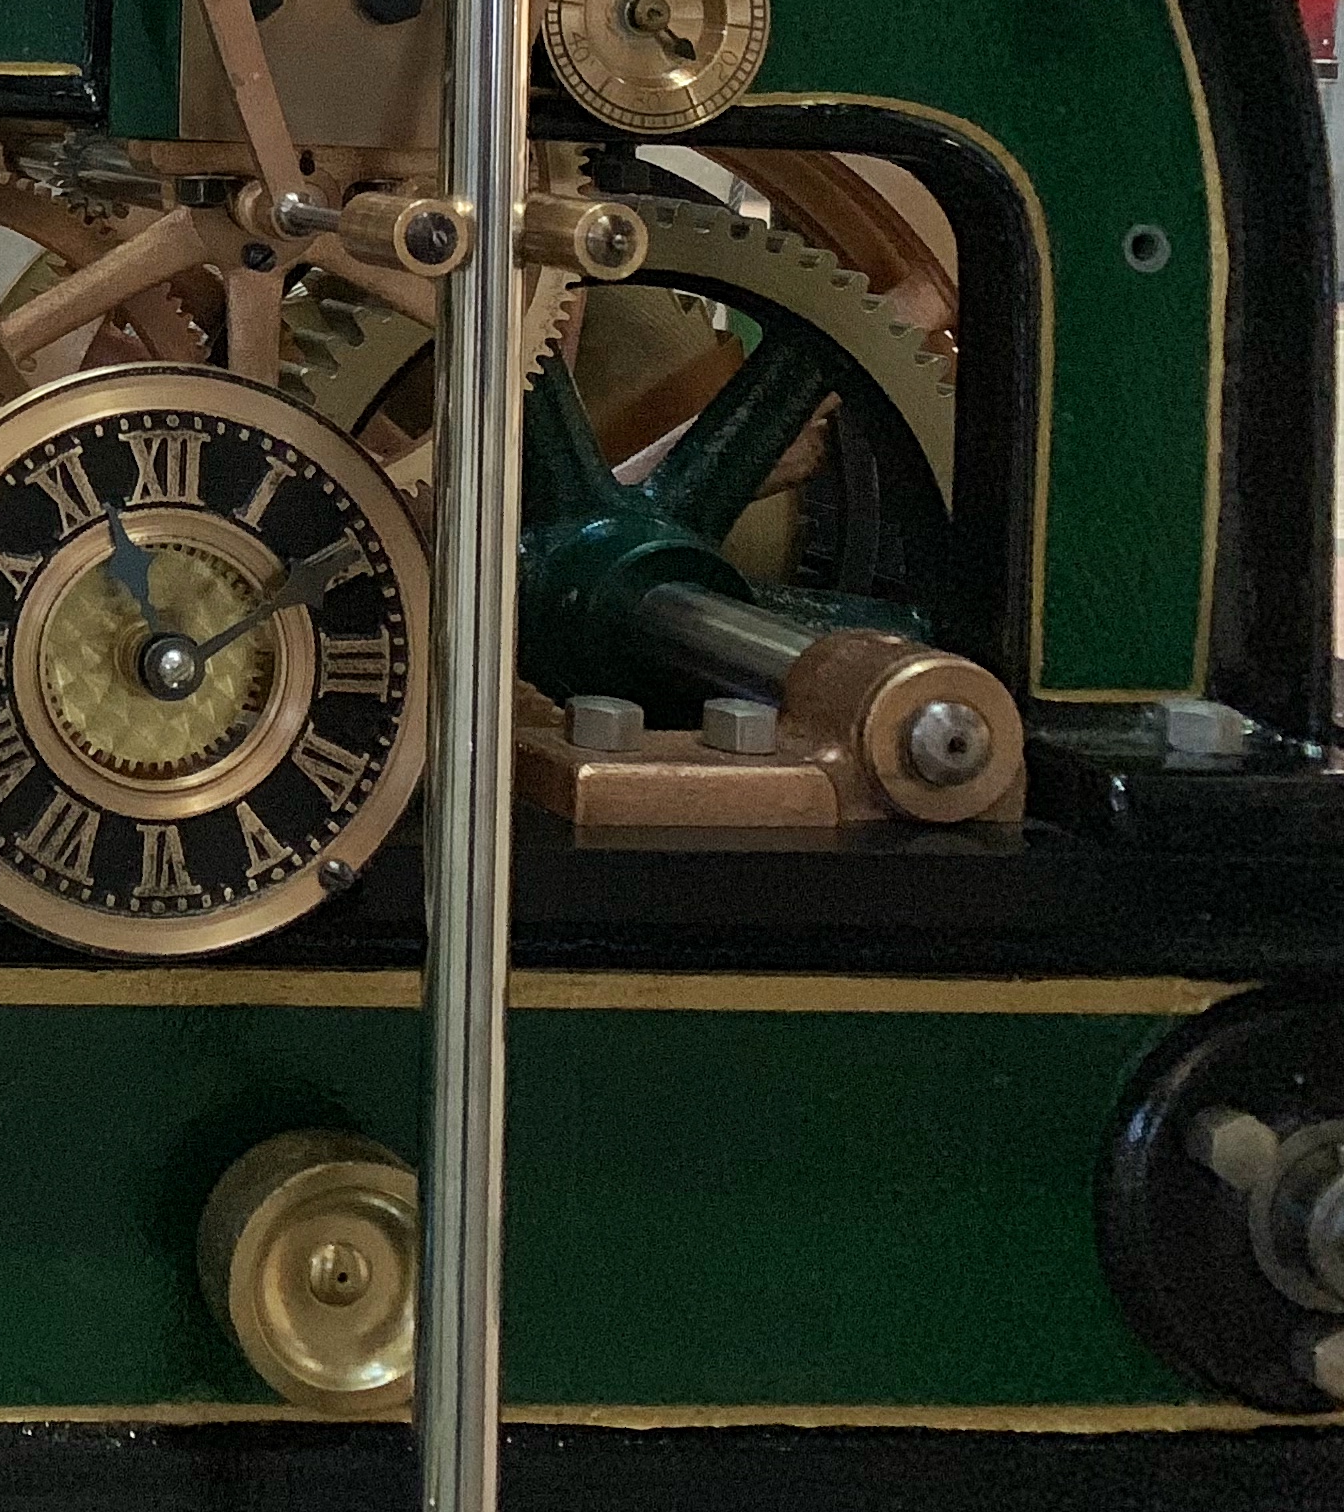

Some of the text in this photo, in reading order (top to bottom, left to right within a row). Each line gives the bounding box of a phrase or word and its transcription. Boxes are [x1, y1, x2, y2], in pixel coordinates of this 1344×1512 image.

[568, 31, 590, 62] 40
[713, 50, 738, 80] 20
[25, 445, 107, 539] XI
[118, 429, 210, 508] XII
[233, 455, 296, 532] I
[318, 624, 390, 703] III
[14, 785, 101, 887] VII
[133, 824, 202, 898] VI
[236, 800, 293, 878] V
